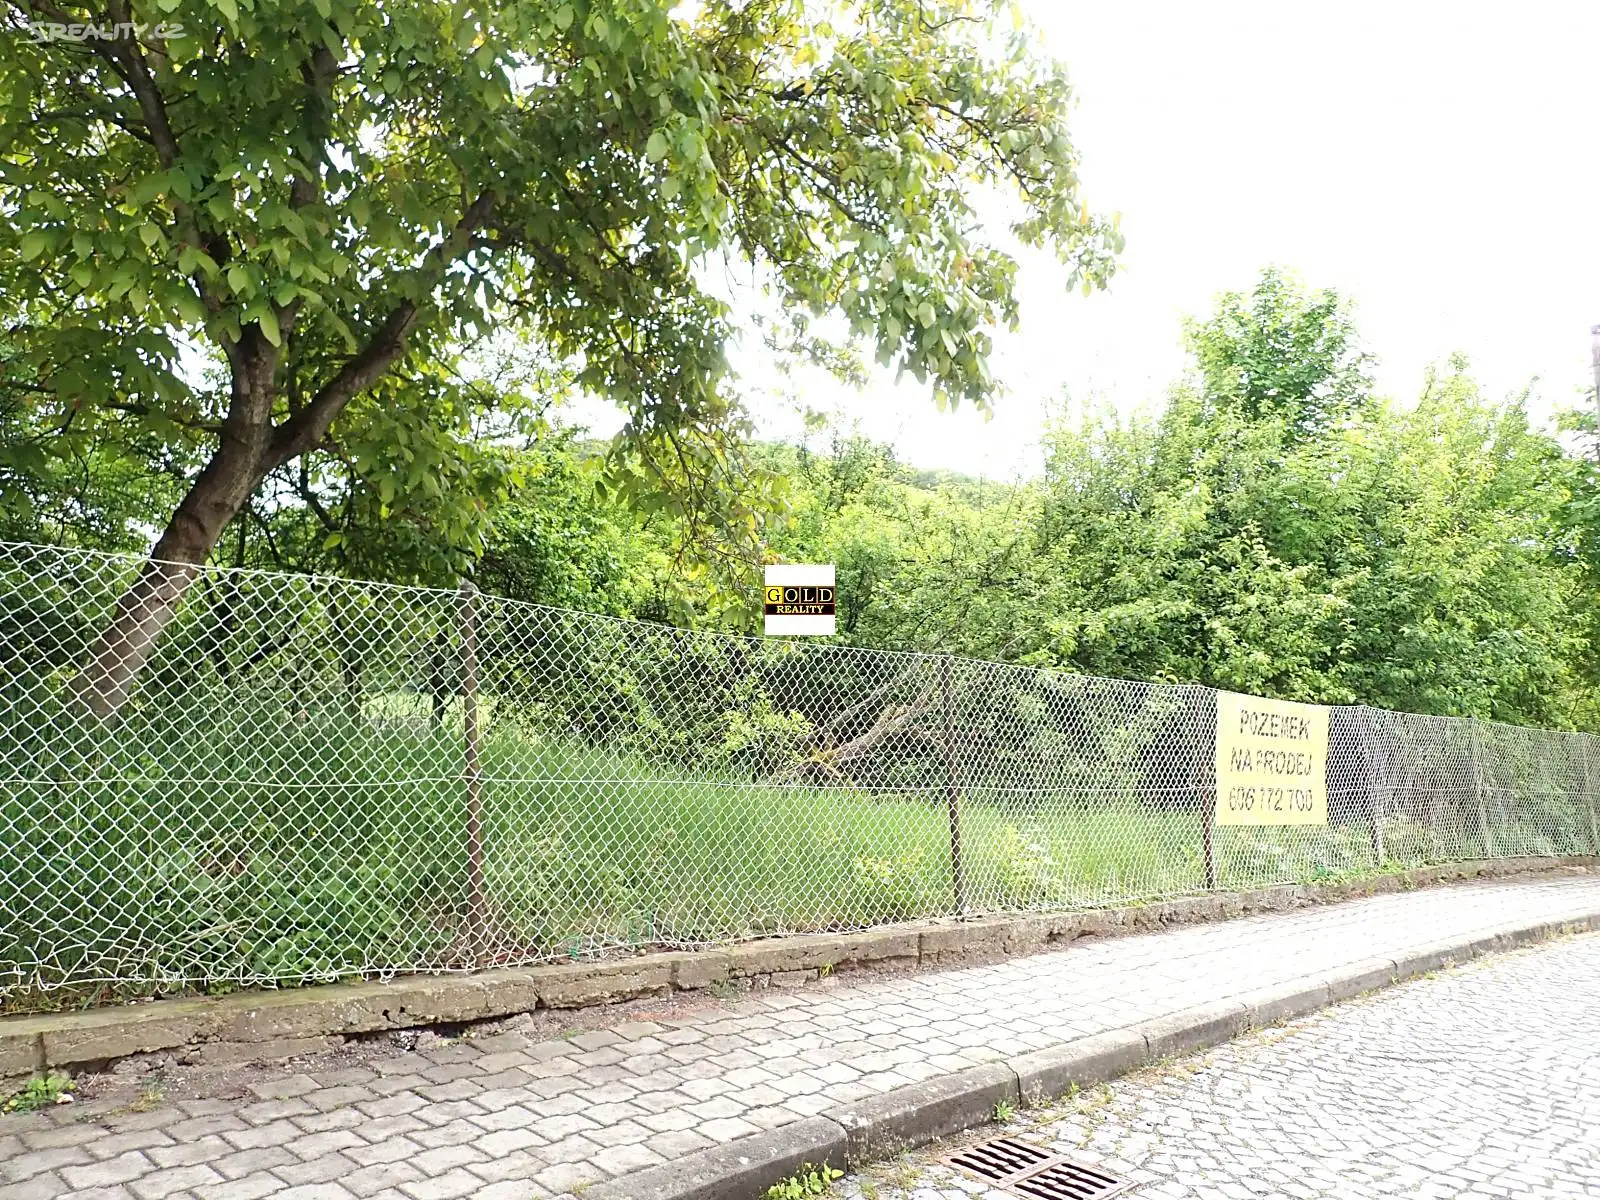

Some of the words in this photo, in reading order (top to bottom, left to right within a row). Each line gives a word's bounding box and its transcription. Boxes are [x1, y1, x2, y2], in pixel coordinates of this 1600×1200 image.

[1240, 709, 1310, 740] POZEMEK
[1230, 746, 1253, 773] NA
[1256, 749, 1312, 776] PRODEJ
[1228, 786, 1255, 811] 606
[1259, 787, 1283, 811] 772
[1286, 788, 1313, 812] 700
